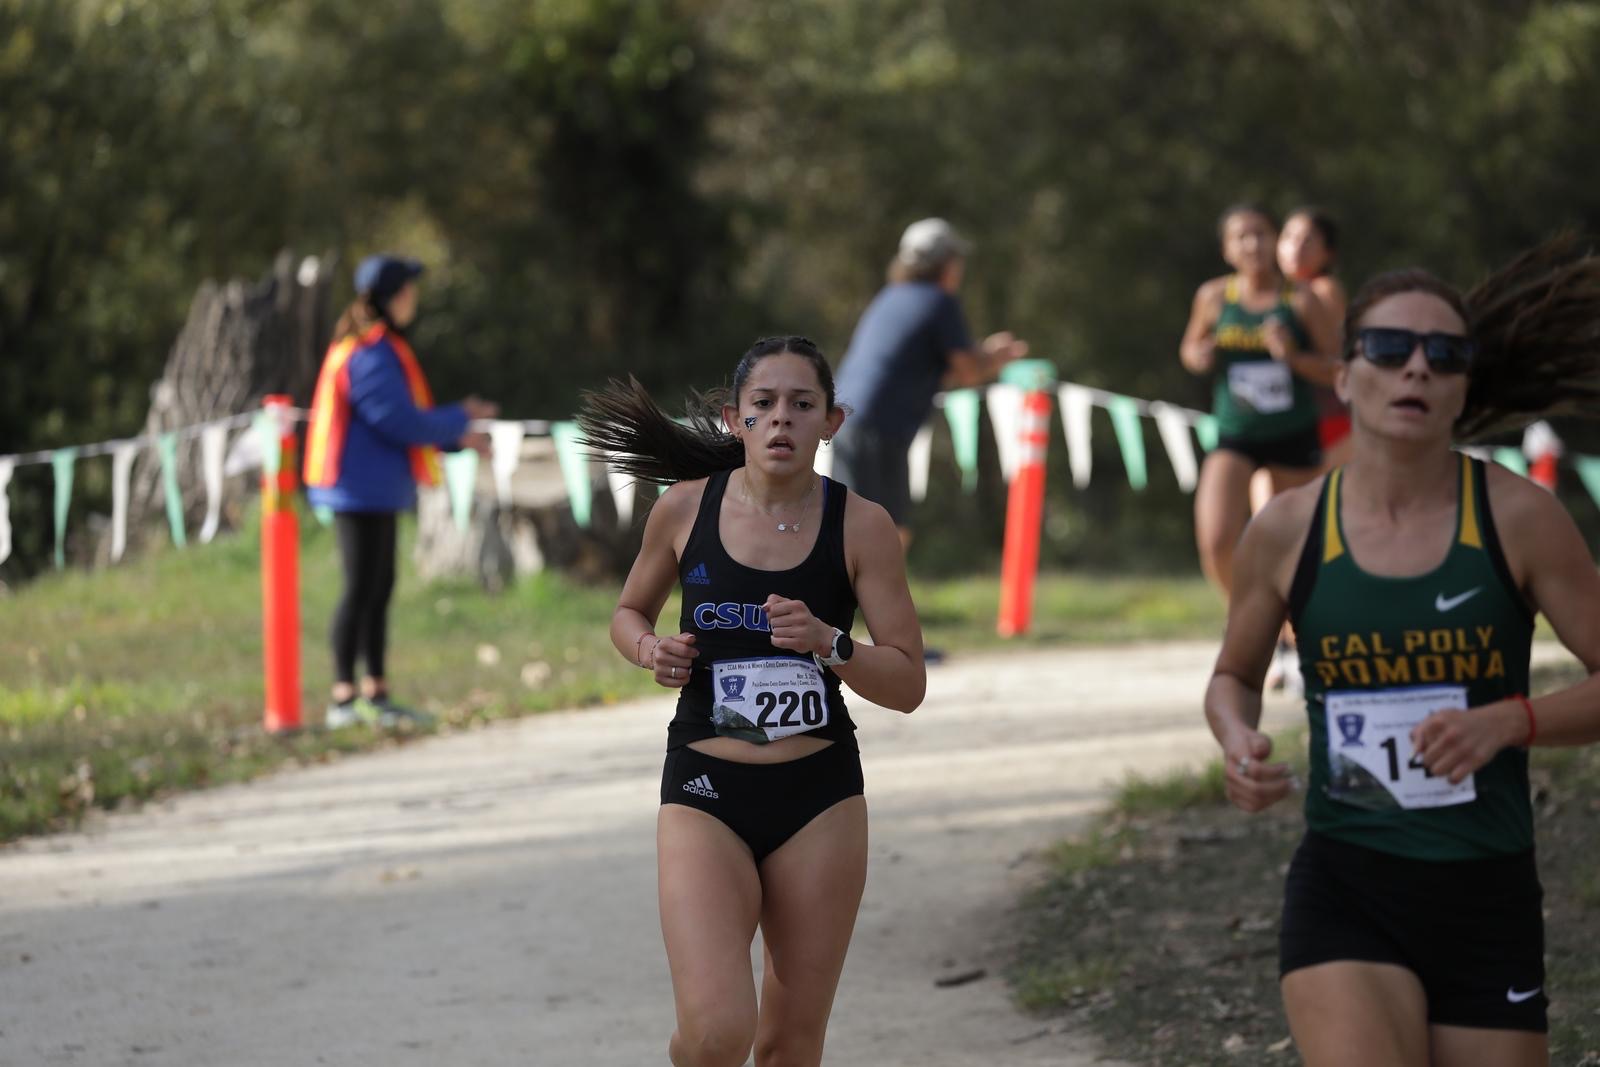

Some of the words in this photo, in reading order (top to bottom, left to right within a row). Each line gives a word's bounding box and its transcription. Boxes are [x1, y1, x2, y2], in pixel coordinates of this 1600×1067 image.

[693, 602, 771, 632] CSU
[1320, 631, 1393, 660] CAL
[1403, 624, 1494, 654] POLY
[1314, 649, 1506, 688] POMONA
[755, 690, 824, 728] 220
[682, 784, 719, 799] adidas
